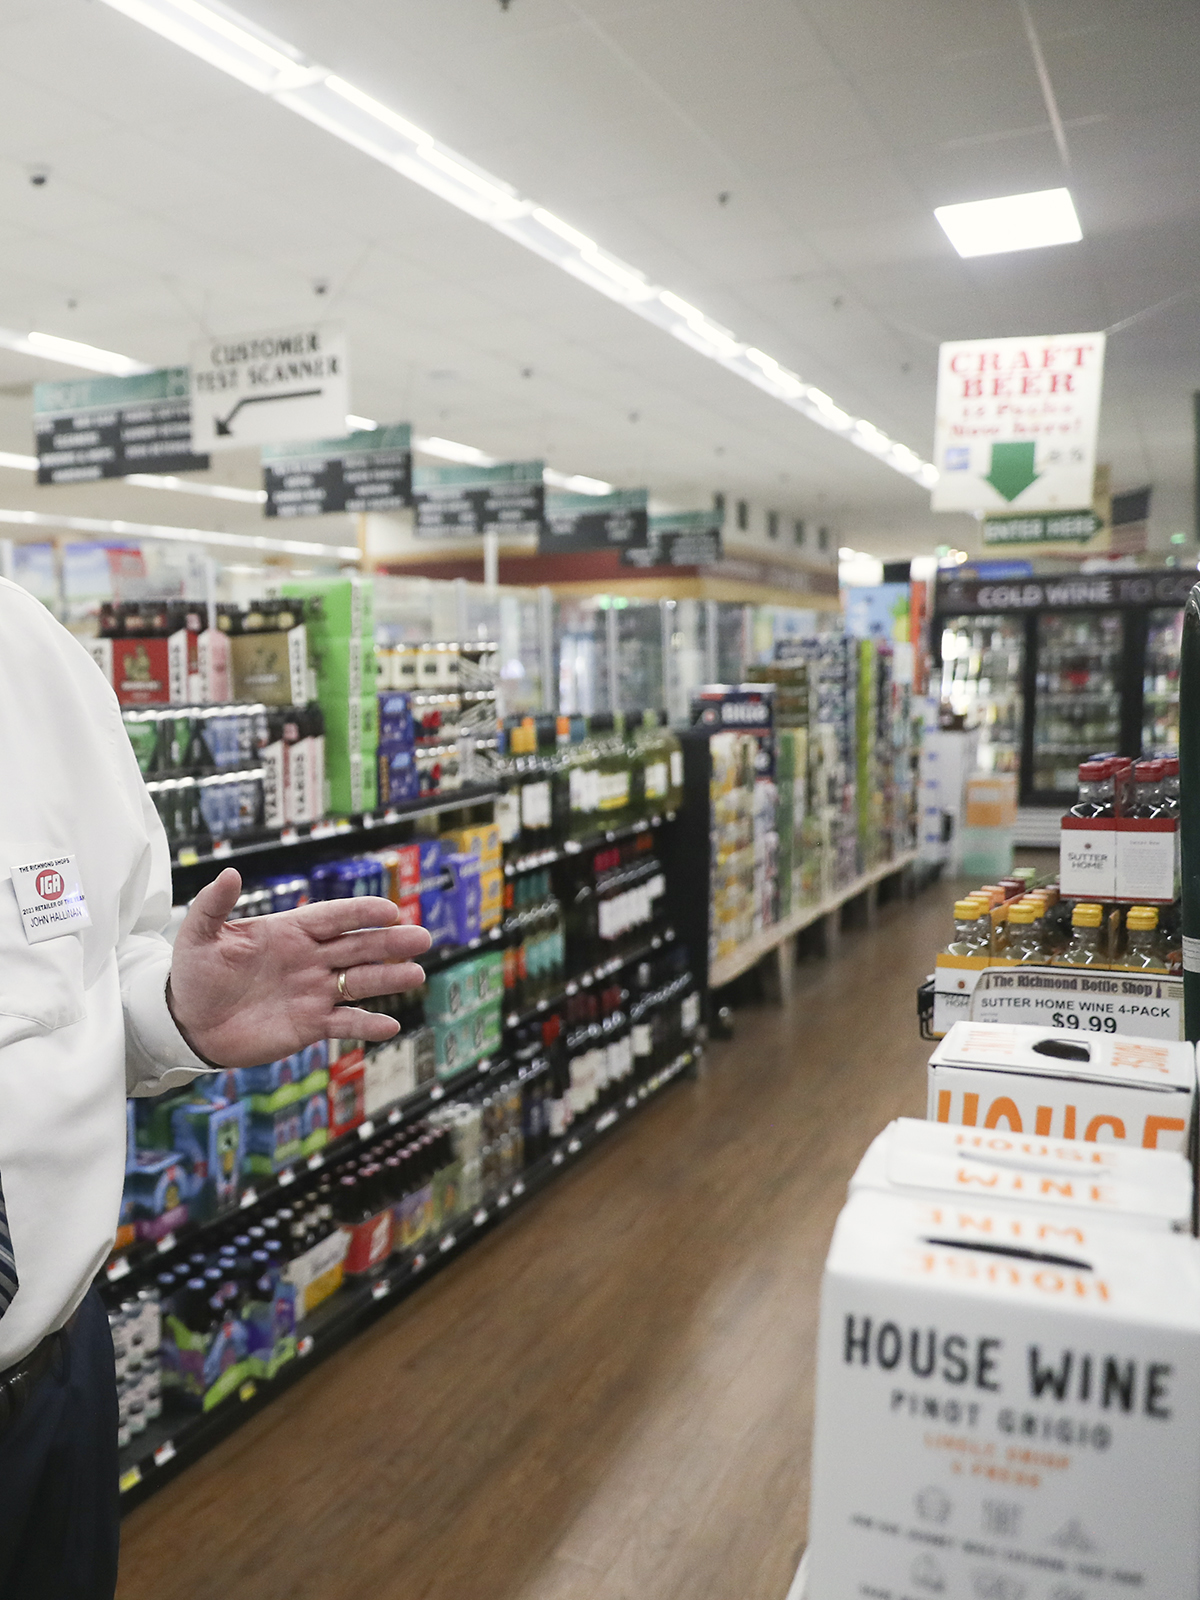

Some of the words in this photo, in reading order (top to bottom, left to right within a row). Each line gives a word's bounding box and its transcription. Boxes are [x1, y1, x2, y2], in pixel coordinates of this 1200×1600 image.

[210, 331, 320, 366] CUSTOMER
[950, 346, 1095, 373] CRAFT
[197, 370, 242, 392] TEST
[249, 355, 340, 387] SCANNER
[962, 373, 1076, 398] BEER
[976, 585, 1043, 609] COLD
[1067, 852, 1108, 861] SUTTER
[1071, 861, 1104, 870] HOME
[39, 873, 61, 896] IGA
[35, 902, 57, 912] RETAILER
[30, 914, 50, 928] JOHN
[993, 974, 1015, 988] The
[1017, 974, 1078, 991] Richmond
[1081, 978, 1118, 993] Bottle
[1121, 981, 1153, 997] Shop
[981, 997, 1031, 1009] SUTTER
[1035, 999, 1075, 1011] HOME
[1079, 1001, 1114, 1014] WINE
[1118, 1004, 1171, 1018] 4-PACK
[1051, 1012, 1117, 1034] $9.99
[956, 1168, 1116, 1206] WINE
[842, 1312, 1001, 1393] HOUSE
[1027, 1343, 1174, 1421] WINE
[890, 1388, 980, 1429] PINOT
[997, 1407, 1114, 1453] GRIGIO
